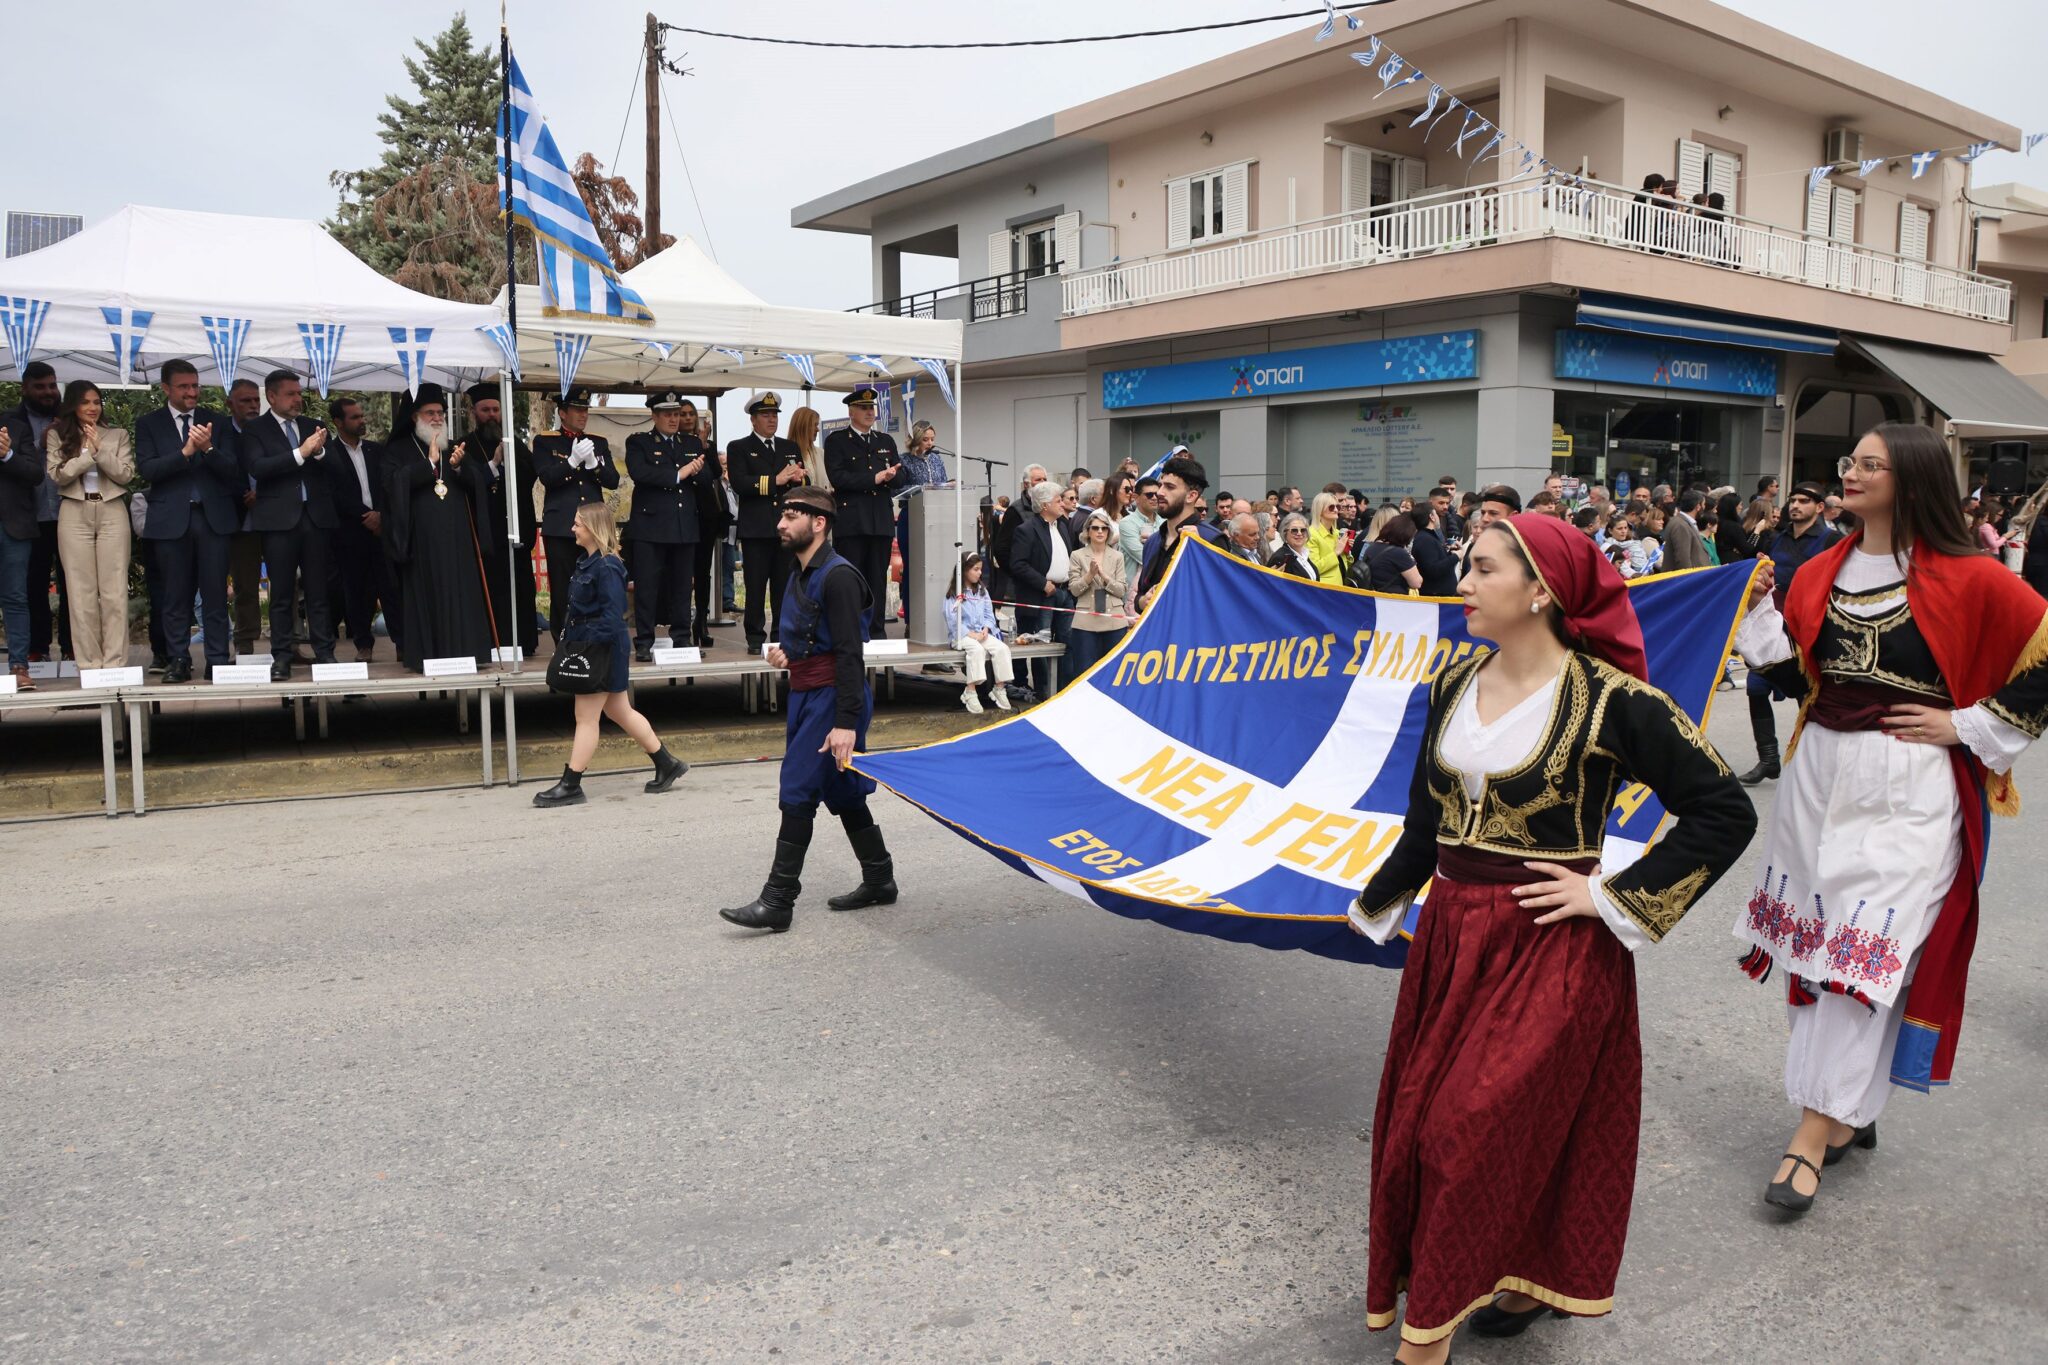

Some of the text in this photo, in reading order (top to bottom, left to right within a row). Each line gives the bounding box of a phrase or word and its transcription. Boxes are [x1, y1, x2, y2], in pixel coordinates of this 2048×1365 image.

[1112, 630, 1491, 687] ΠΟΛΙΤΙΣΤΙΚΟΣ ΣΥΛΛΟΓ
[1118, 745, 1405, 884] ΝΕΑ ΓΕΝ
[1047, 828, 1144, 875] ΕΤΟΣ
